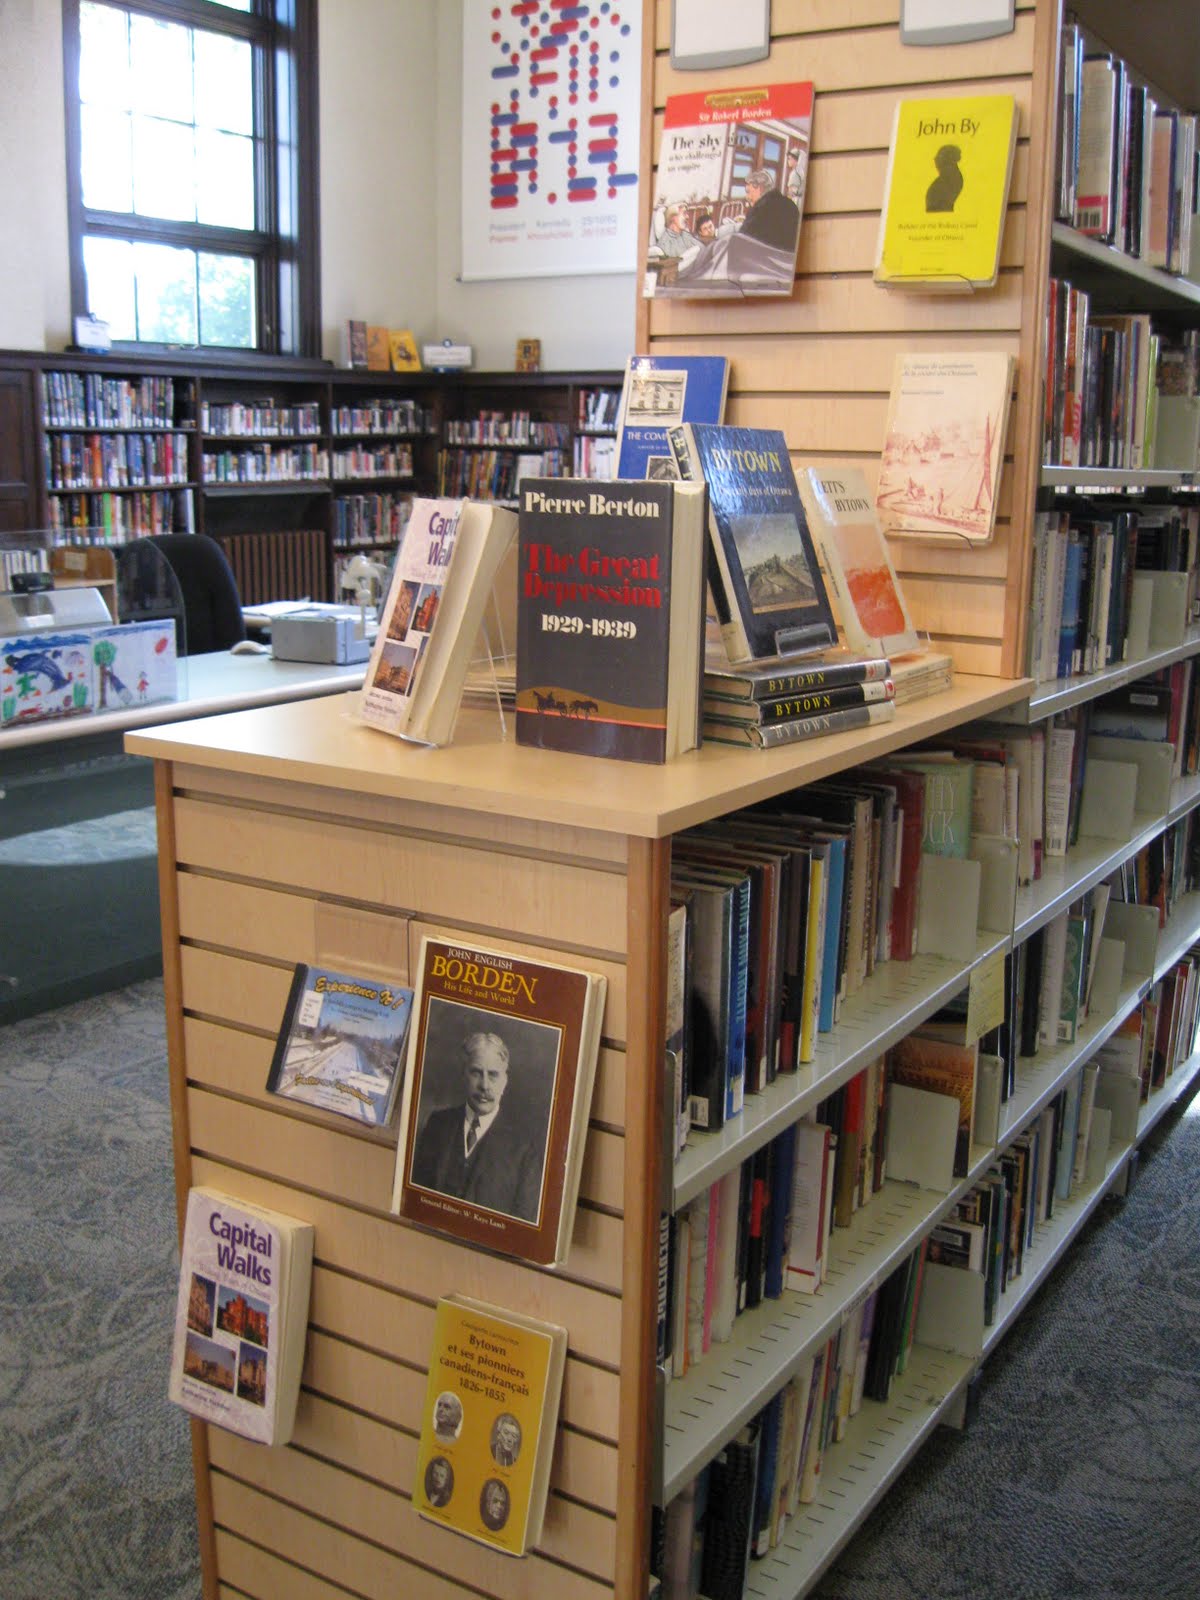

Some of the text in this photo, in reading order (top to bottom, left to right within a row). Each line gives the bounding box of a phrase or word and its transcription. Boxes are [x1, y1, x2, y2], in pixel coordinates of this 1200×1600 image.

[712, 109, 739, 121] Robert
[742, 107, 772, 119] Borden
[917, 118, 980, 138] John By
[672, 135, 695, 151] The
[698, 134, 722, 152] shy
[627, 431, 668, 441] THE COM
[710, 448, 783, 473] BYTOWN
[524, 490, 661, 519] Pierre Berton
[834, 498, 870, 512] BYTOWN
[523, 542, 662, 581] The Great
[523, 571, 662, 609] Depression
[540, 613, 638, 641] 1929-1939
[768, 671, 826, 693] BYTOWN
[775, 695, 832, 717] BYTOWN
[774, 718, 832, 739] BYTOWN
[447, 948, 513, 971] JOHN ENGLISH
[314, 976, 379, 1000] Experience
[431, 955, 539, 1005] BORDEN
[443, 980, 515, 1005] His Life and World
[209, 1211, 273, 1258] Capital
[217, 1243, 272, 1287] Walks
[469, 1334, 507, 1357] Bytown
[447, 1344, 525, 1378] et ses pionniers
[439, 1356, 530, 1397] canadiens-français
[459, 1376, 506, 1403] 1826-1855
